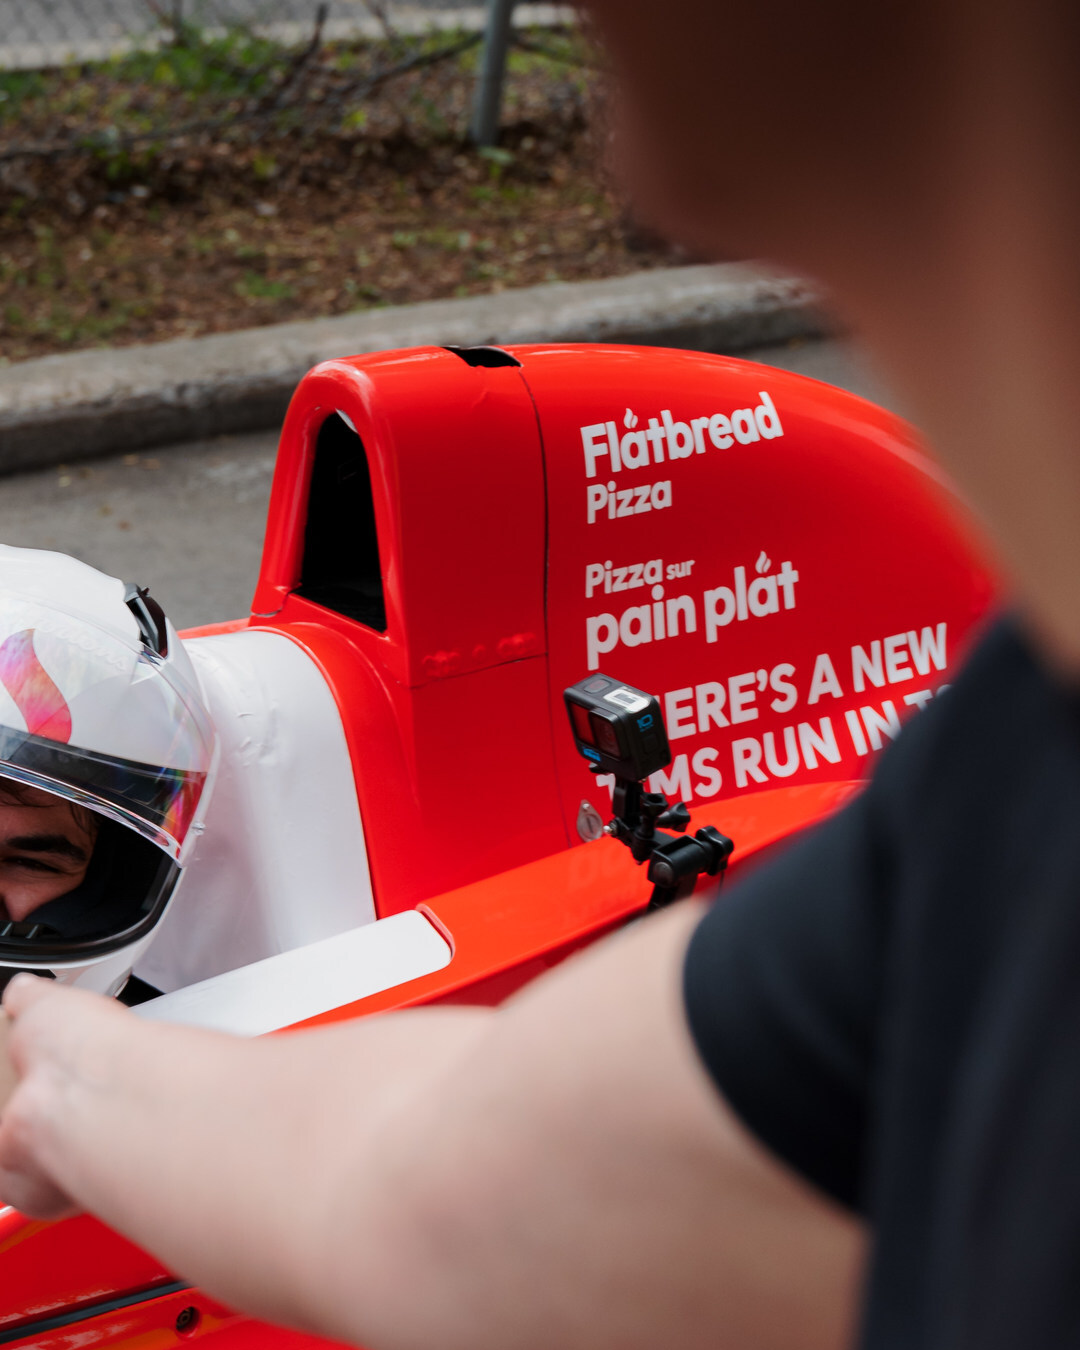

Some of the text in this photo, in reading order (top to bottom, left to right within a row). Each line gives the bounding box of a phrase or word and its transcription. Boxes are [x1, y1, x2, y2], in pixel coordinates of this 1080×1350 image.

[580, 391, 784, 477] Flatbread
[587, 481, 672, 523] Pizza
[585, 559, 694, 598] Pizza sur
[586, 551, 799, 670] pain plat
[808, 653, 844, 705] A
[851, 623, 947, 693] NEW
[732, 717, 841, 788] RUN
[845, 700, 901, 756] IN
